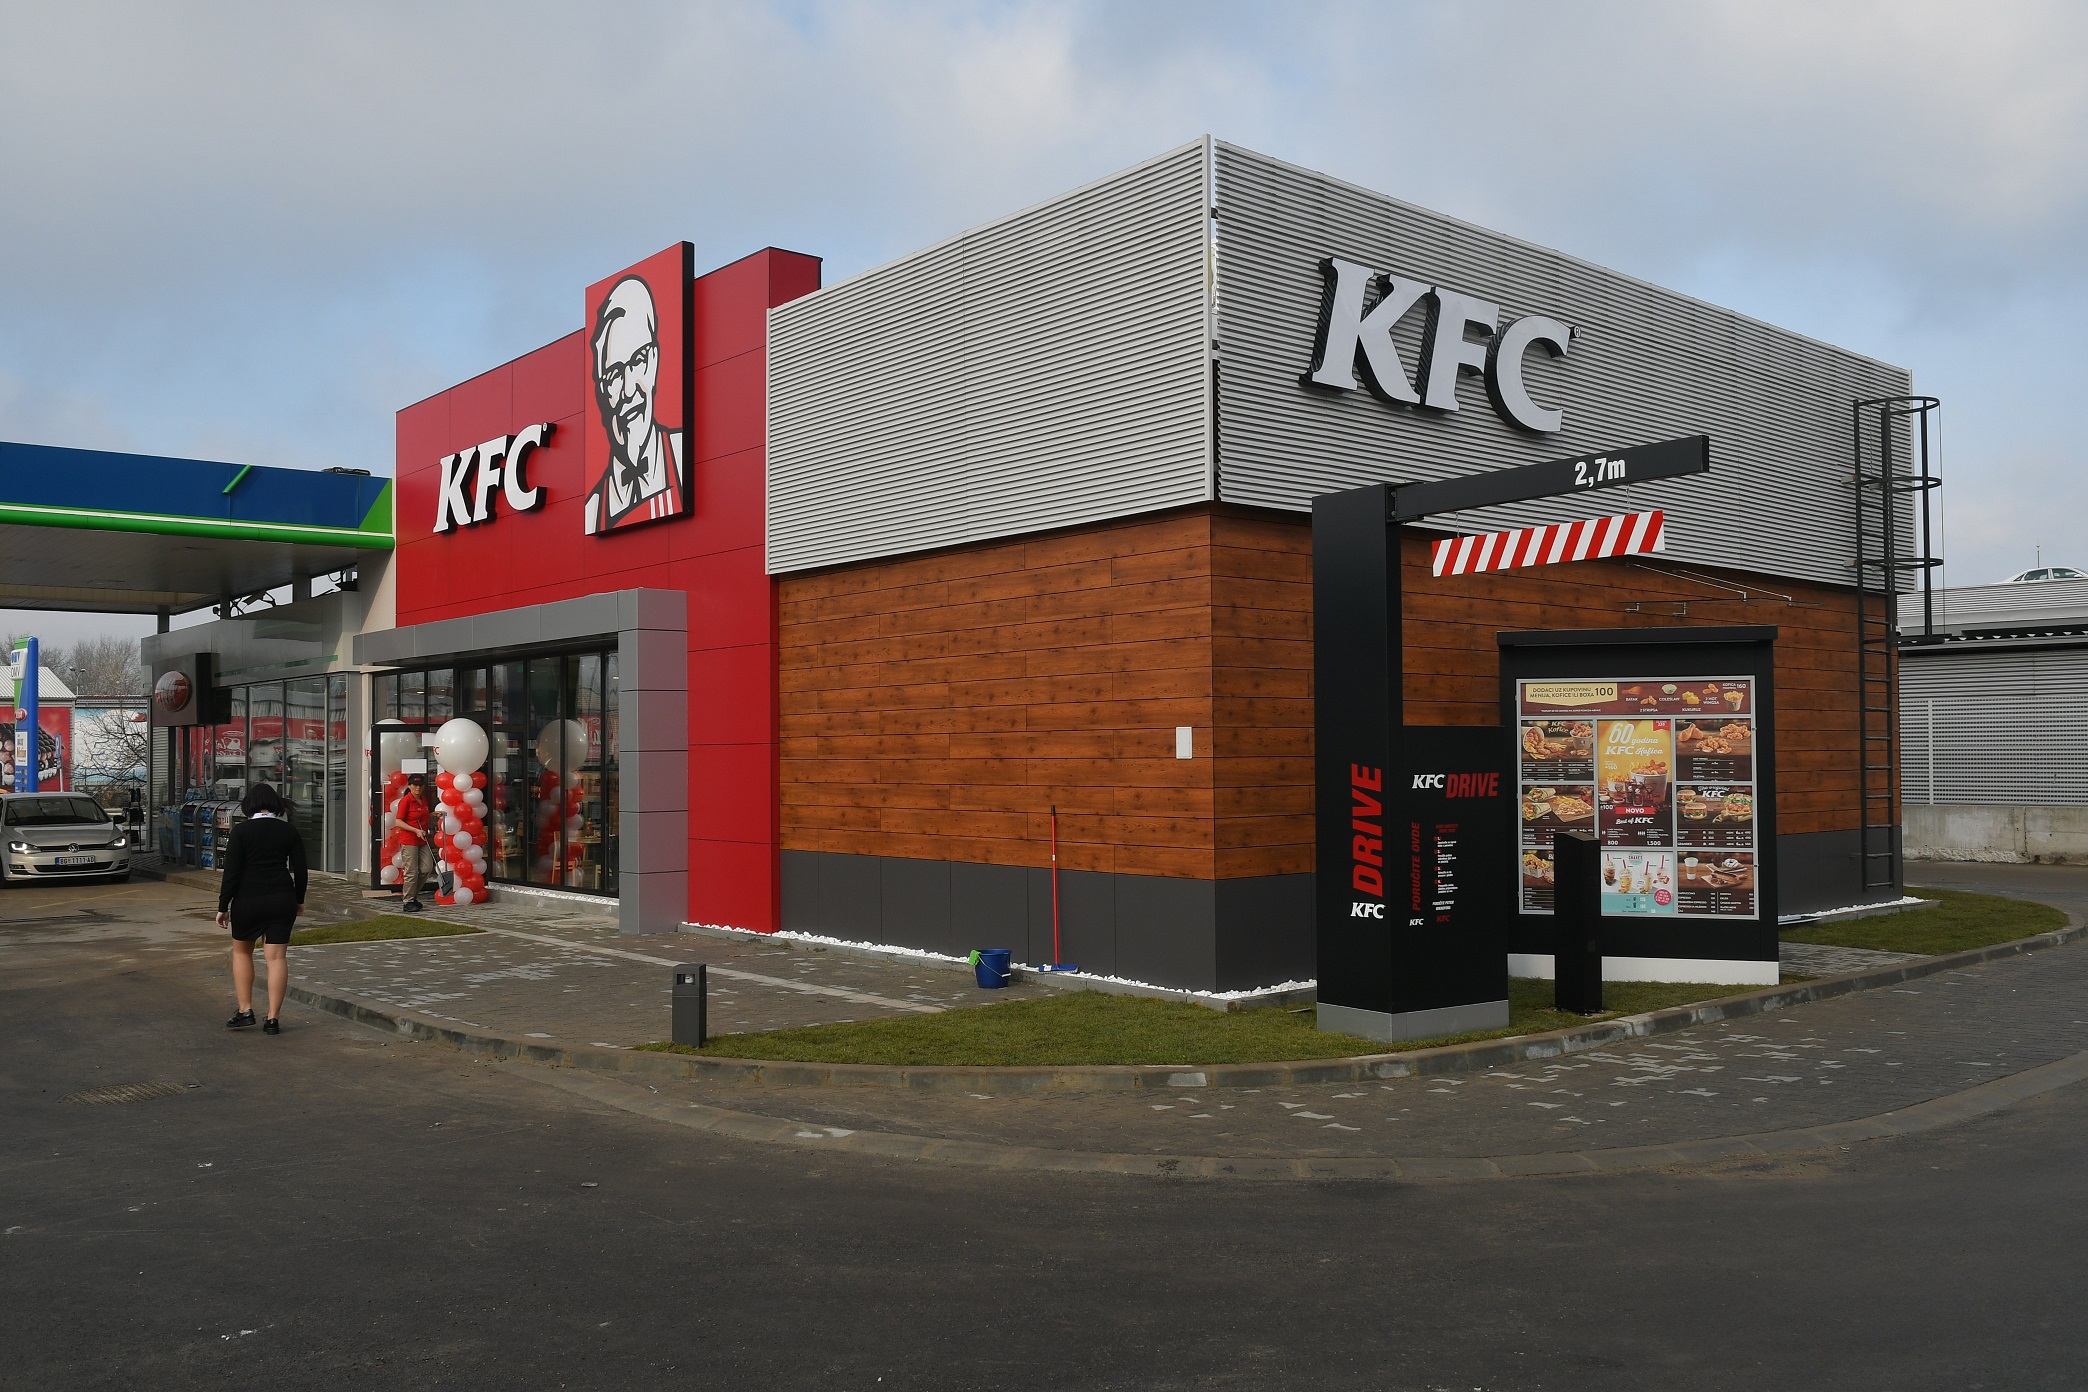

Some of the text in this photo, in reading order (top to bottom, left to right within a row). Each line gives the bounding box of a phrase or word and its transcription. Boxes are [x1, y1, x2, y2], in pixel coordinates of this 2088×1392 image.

[1308, 256, 1571, 433] KFC
[432, 423, 547, 534] KFC
[1574, 457, 1626, 487] 2,7m
[1595, 687, 1614, 696] 100
[1608, 722, 1659, 745] 60 godina
[1605, 746, 1635, 755] KFC
[1412, 773, 1499, 798] KFC DRIVE
[1702, 790, 1727, 798] KFC
[1351, 763, 1384, 897] DRIVE
[1411, 822, 1421, 911] PORUČITE OVDE
[1350, 902, 1386, 919] KFC
[1410, 918, 1424, 926] KFC
